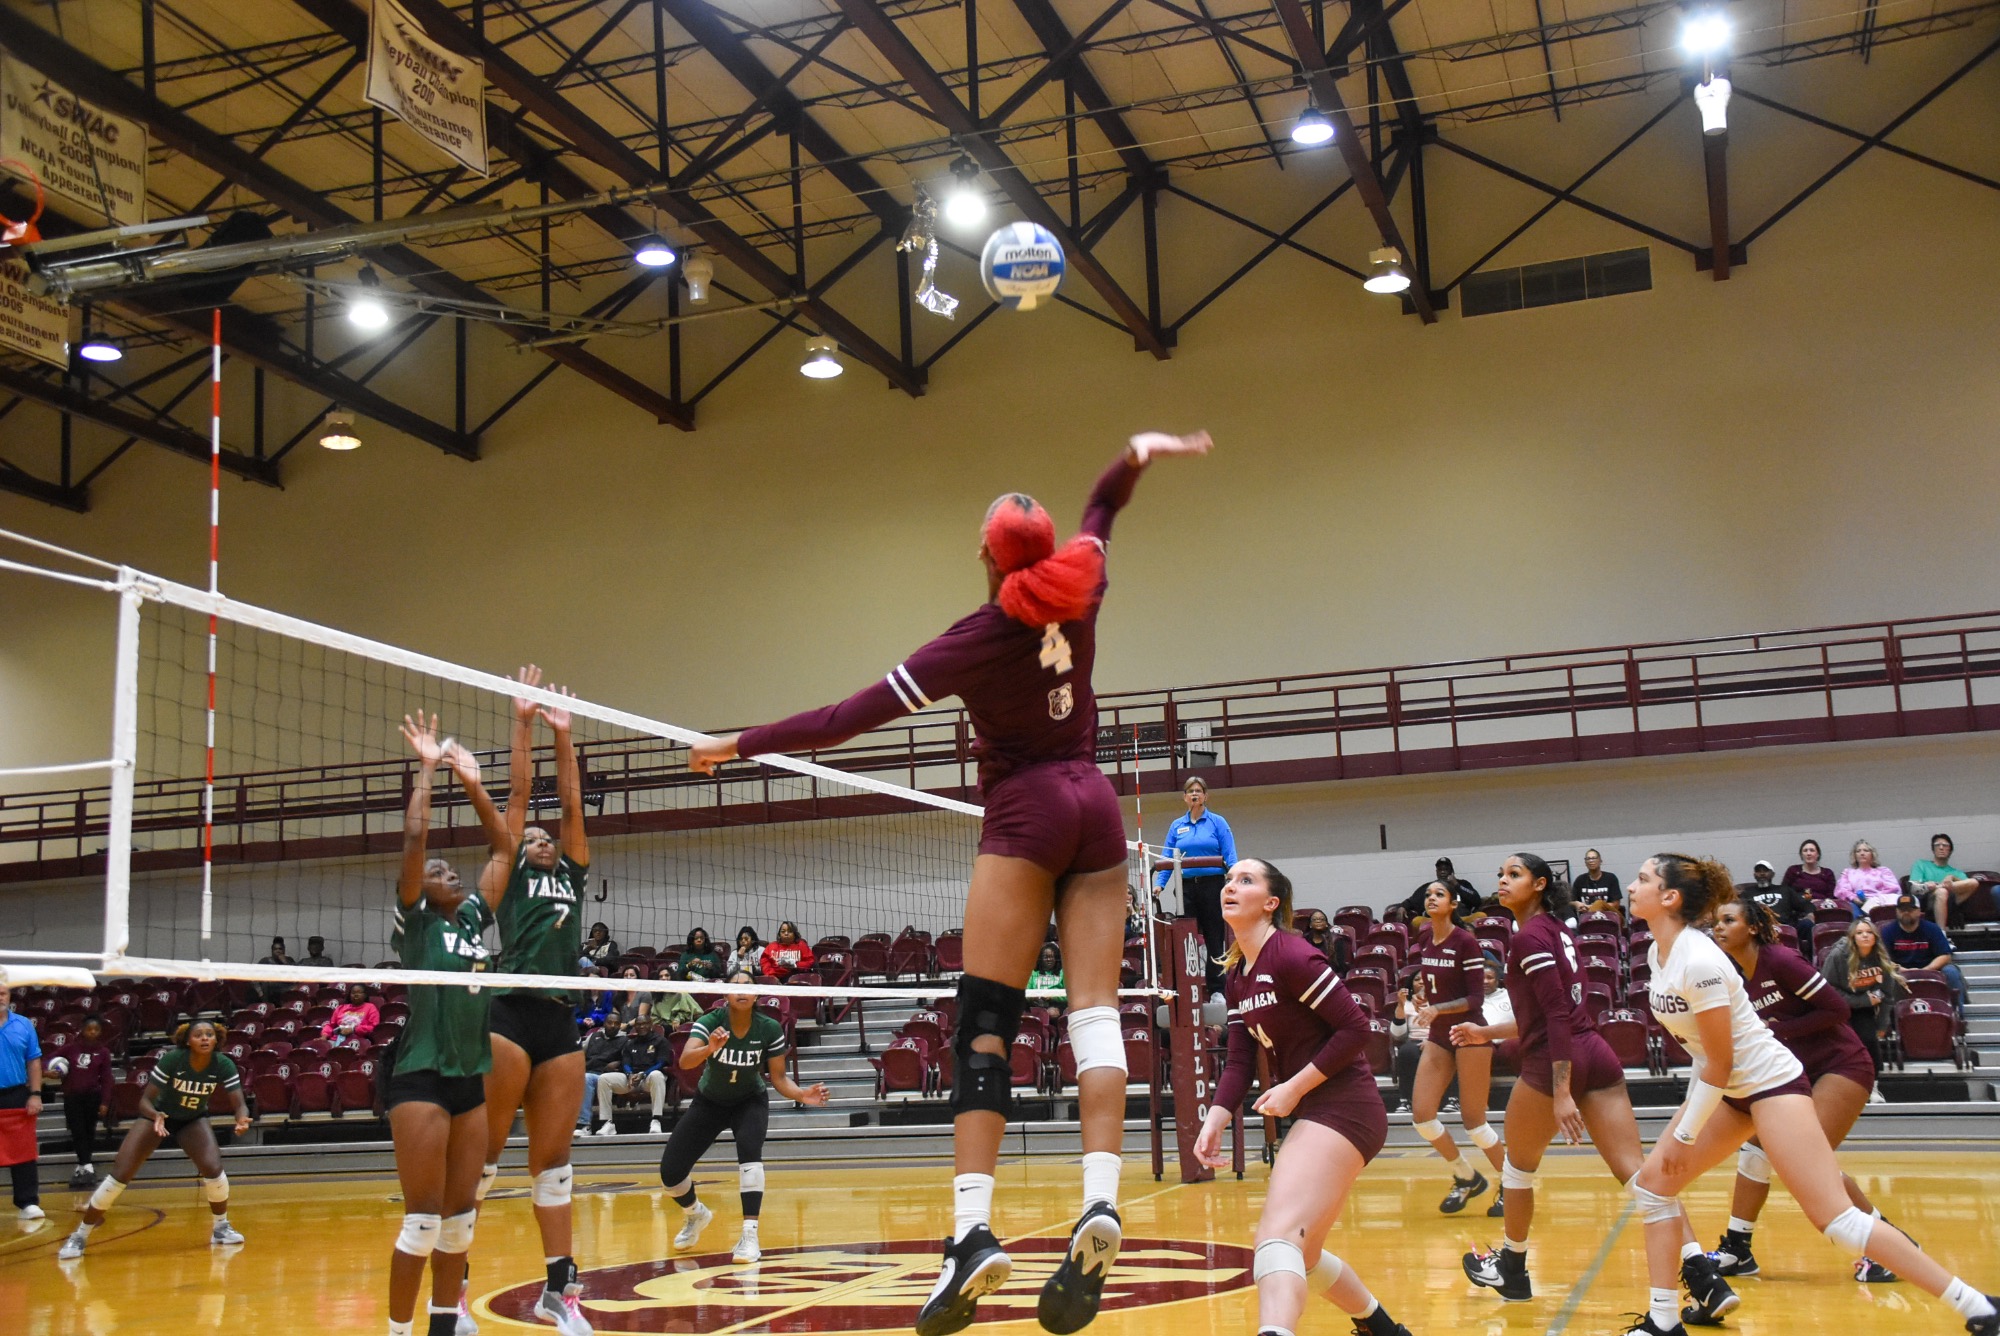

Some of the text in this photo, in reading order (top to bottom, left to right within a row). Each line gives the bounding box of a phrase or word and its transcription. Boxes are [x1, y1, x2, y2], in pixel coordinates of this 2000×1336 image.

[54, 96, 119, 145] SWAC
[20, 135, 56, 167] NCAA
[58, 140, 94, 169] 2008
[71, 129, 142, 175] Chmpions
[43, 163, 117, 212] Appearane
[1005, 247, 1051, 261] molten
[0, 294, 24, 315] 005
[7, 284, 69, 319] Champions
[0, 311, 60, 343] ournament
[0, 324, 42, 350] earance
[594, 879, 607, 902] J
[553, 903, 570, 929] 7
[1426, 973, 1437, 994] 7
[1702, 977, 1722, 988] SWAC
[1255, 991, 1278, 1009] A&M
[1762, 990, 1784, 1007] A&M
[1191, 984, 1209, 1123] BULLDO
[173, 1077, 218, 1095] VALLEY
[729, 1069, 738, 1083] 1
[180, 1095, 200, 1110] 12
